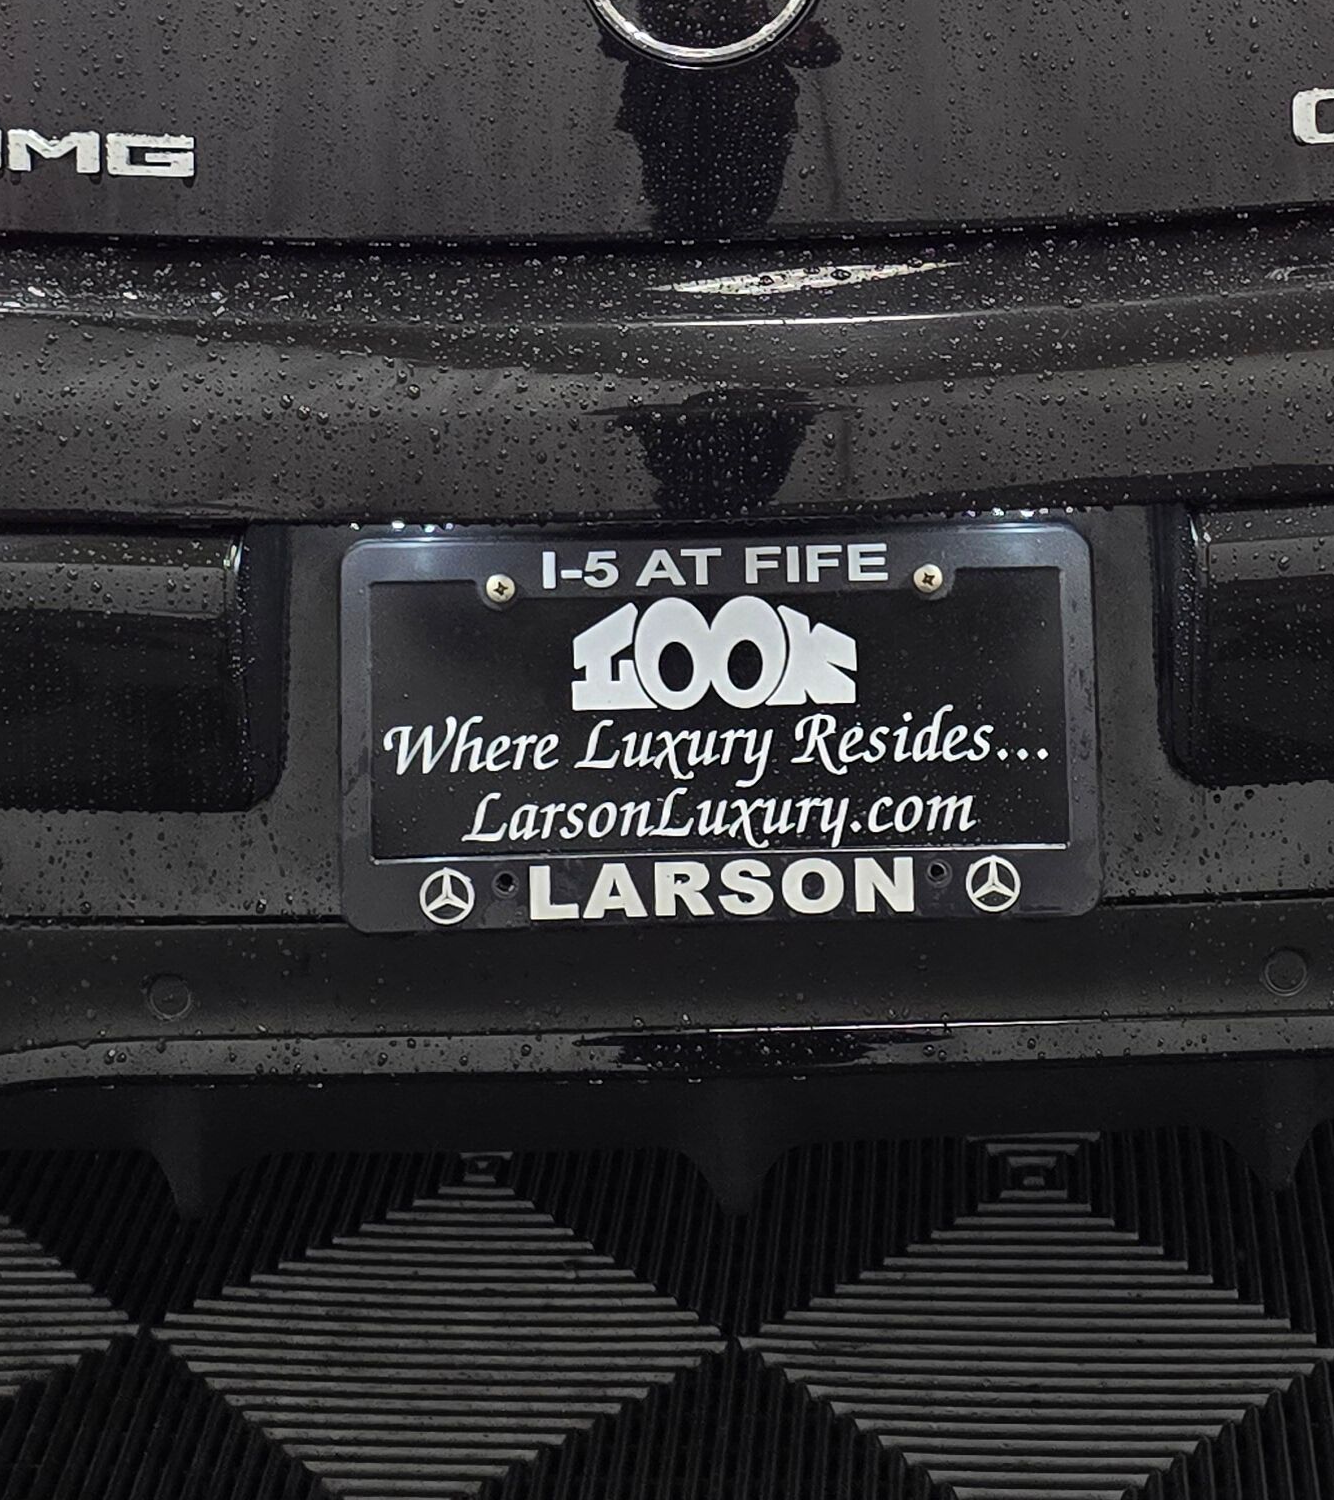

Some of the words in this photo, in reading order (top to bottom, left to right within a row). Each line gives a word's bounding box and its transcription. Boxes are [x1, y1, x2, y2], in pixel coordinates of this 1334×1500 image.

[542, 550, 620, 589] I-5
[635, 547, 722, 587] AT
[745, 542, 889, 584] FIFE
[382, 714, 559, 776] Where
[573, 719, 773, 788] Luxury
[792, 704, 1049, 776] Resides...
[461, 789, 976, 848] LarsonLuxury.com
[528, 856, 915, 921] LARSON
